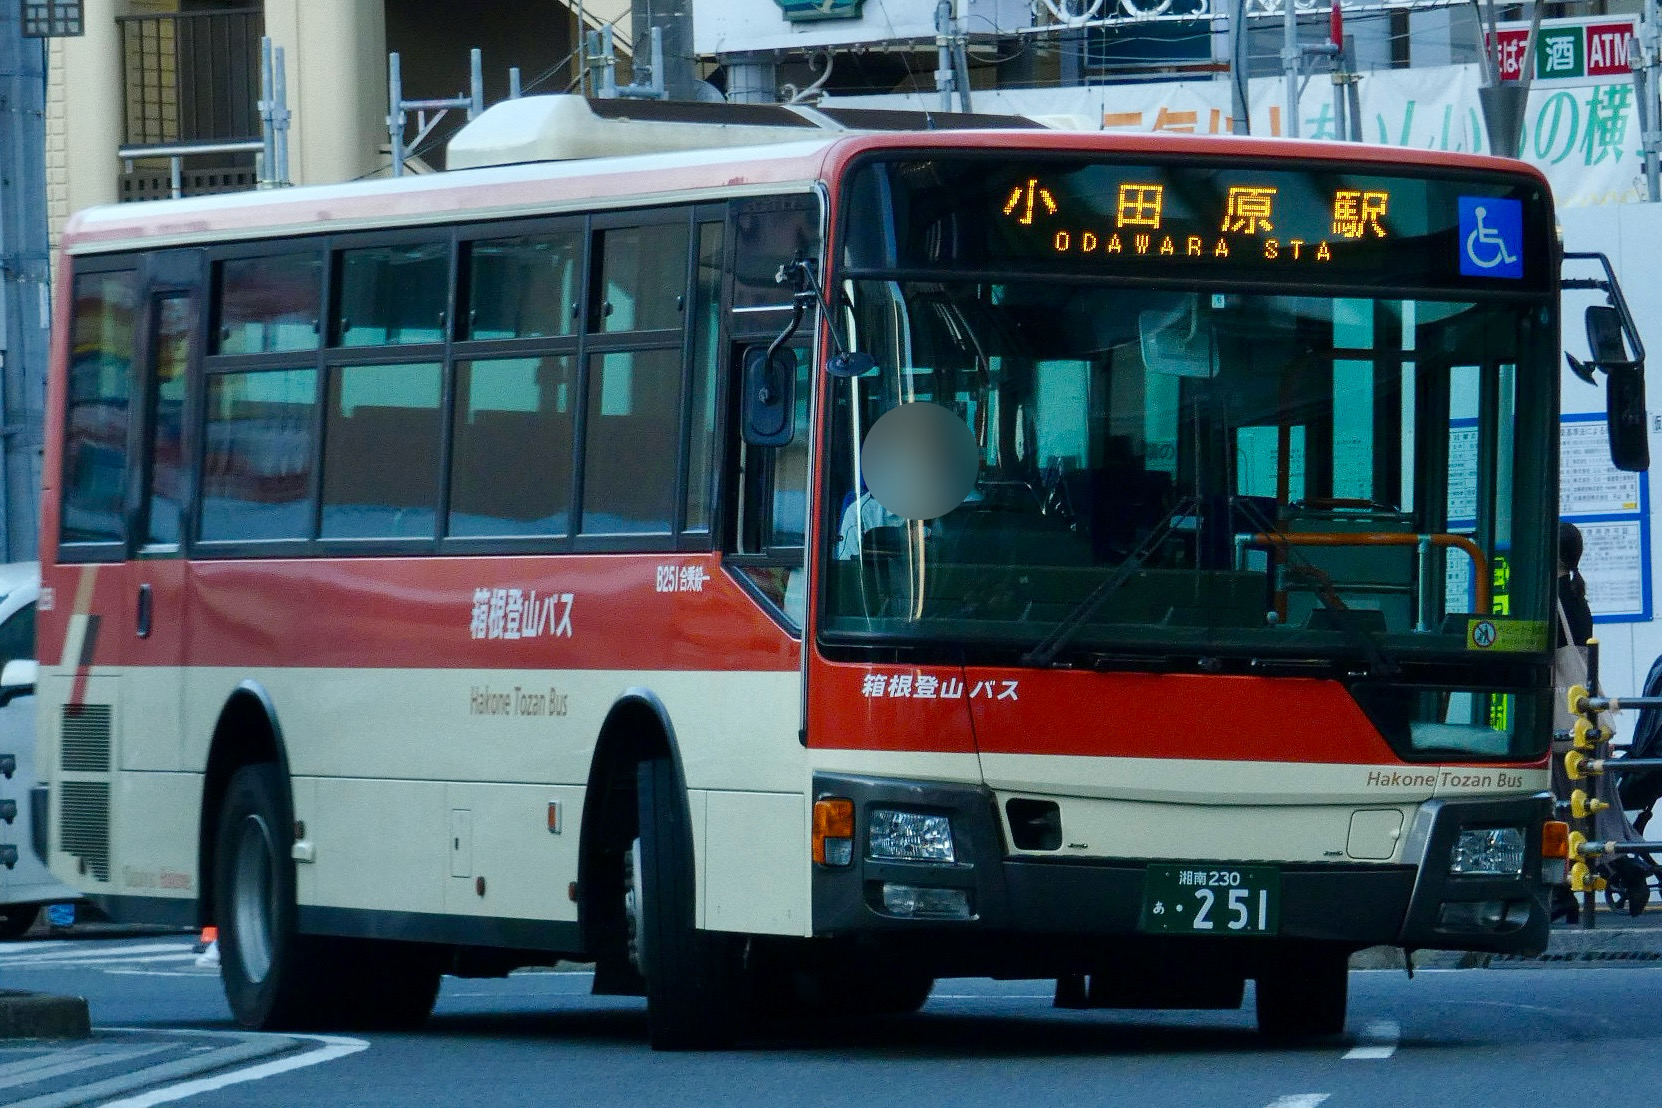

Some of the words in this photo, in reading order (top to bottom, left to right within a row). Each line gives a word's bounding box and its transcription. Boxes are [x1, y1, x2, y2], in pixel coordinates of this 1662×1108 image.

[1545, 36, 1575, 72] 酒
[1590, 33, 1632, 68] ATM
[1002, 178, 1389, 239] 小田原駅
[1055, 231, 1229, 258] ODAWARA
[1264, 239, 1331, 261] STA
[656, 565, 679, 592] B251
[470, 587, 574, 639] 箱根登山バス
[470, 685, 511, 715] Hakone
[514, 686, 546, 715] Tozan
[549, 687, 568, 716] Bus
[861, 673, 1019, 701] 箱根登山バス
[1367, 771, 1435, 786] Hakone
[1441, 772, 1491, 787] Tozan
[1497, 773, 1523, 788] Bus
